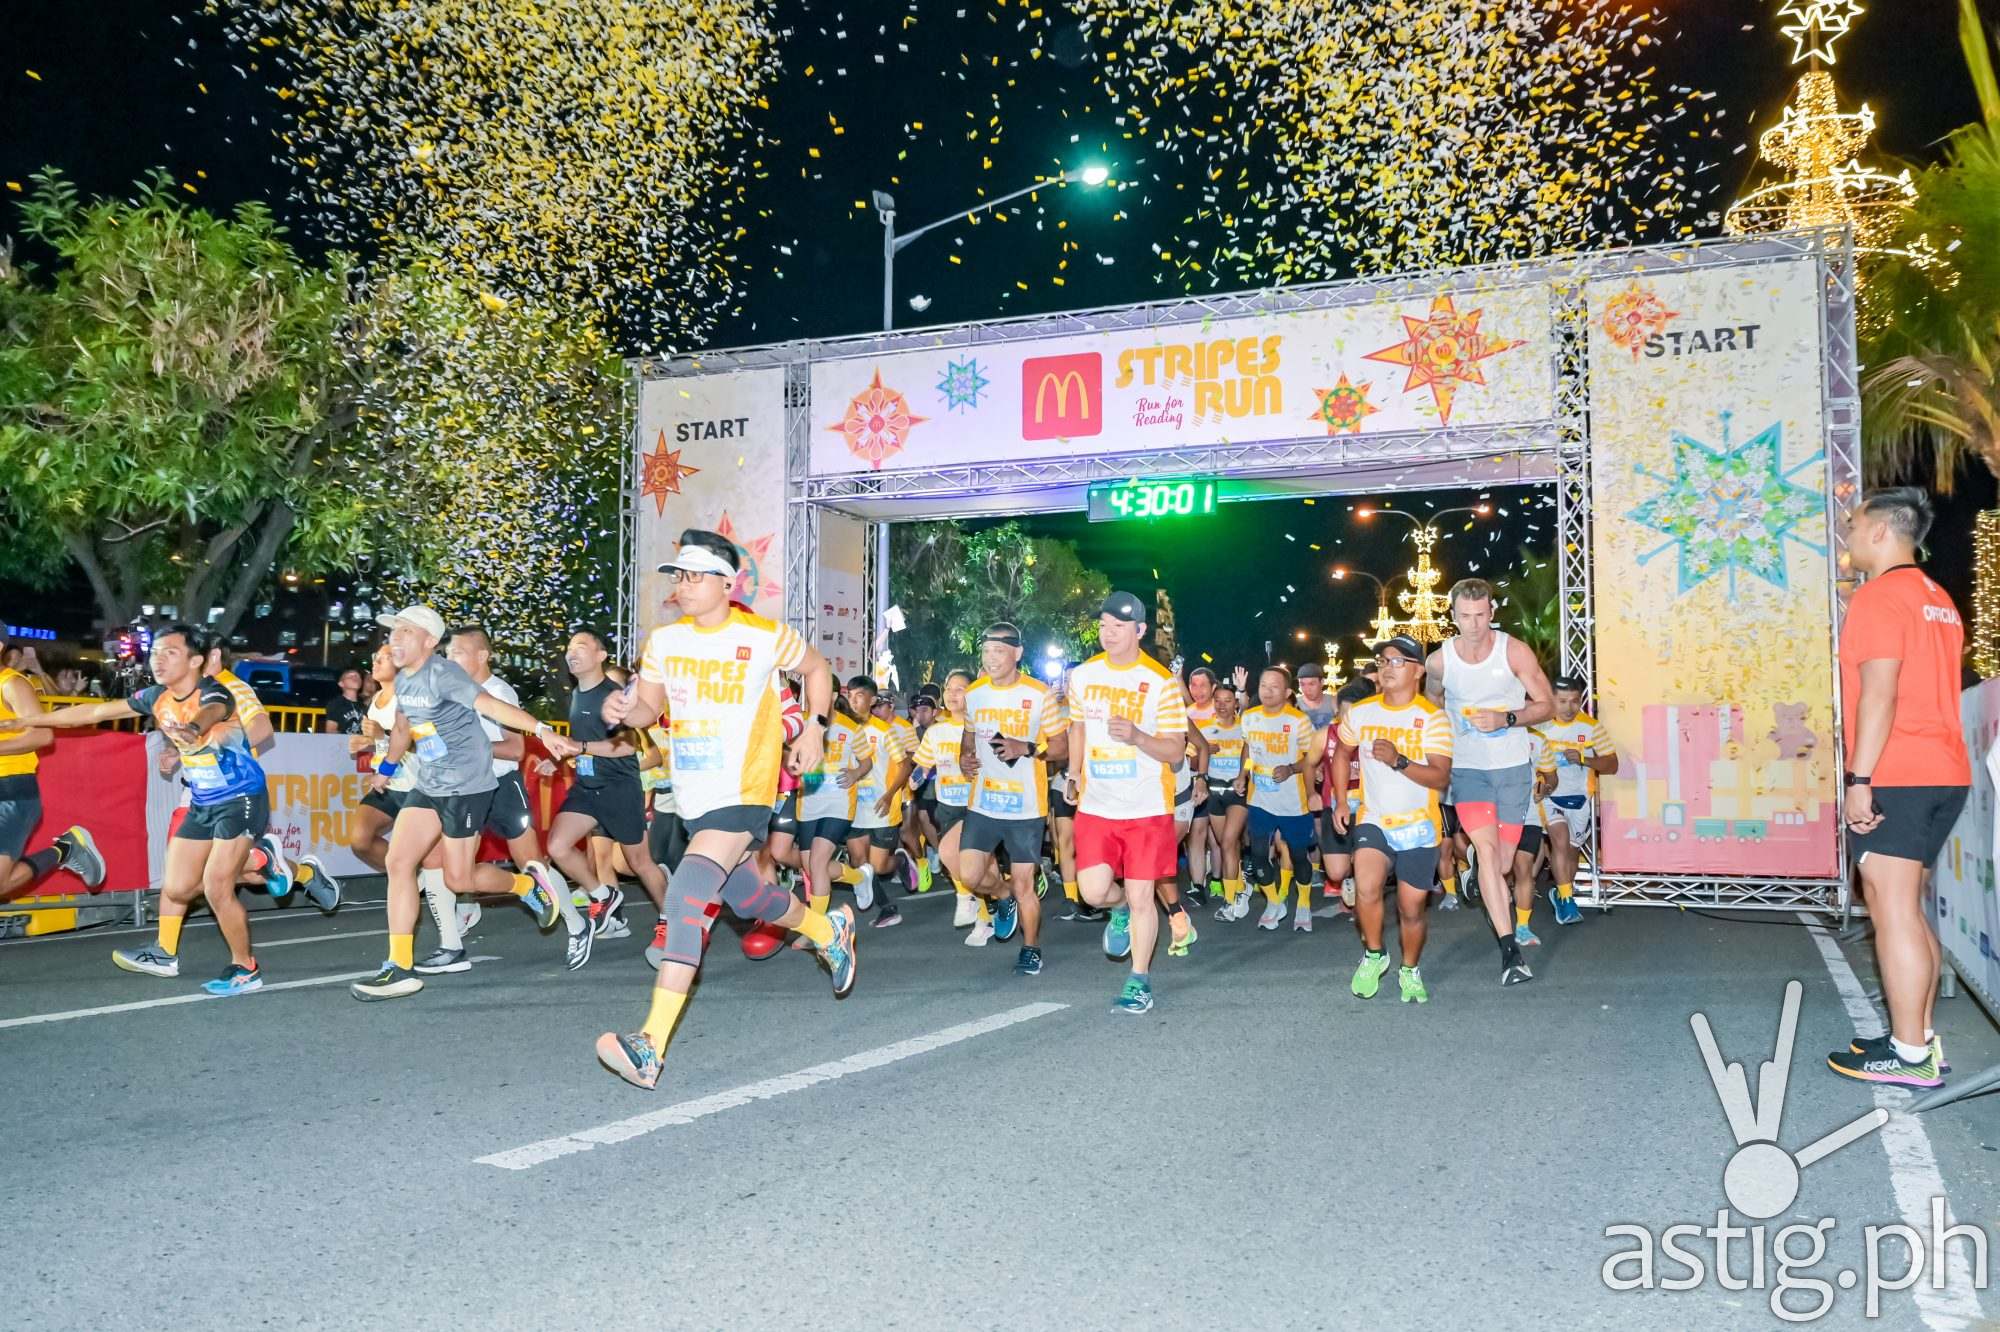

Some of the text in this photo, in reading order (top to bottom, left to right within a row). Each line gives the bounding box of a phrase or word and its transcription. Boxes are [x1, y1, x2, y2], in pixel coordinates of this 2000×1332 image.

[1644, 325, 1760, 358] START
[1115, 335, 1282, 389] STRIPES
[1135, 396, 1184, 414] Run for
[1193, 375, 1282, 424] RUN
[676, 418, 749, 442] START
[1132, 409, 1183, 430] Reading
[697, 680, 745, 705] RUN
[1863, 1058, 1902, 1072] HOKA
